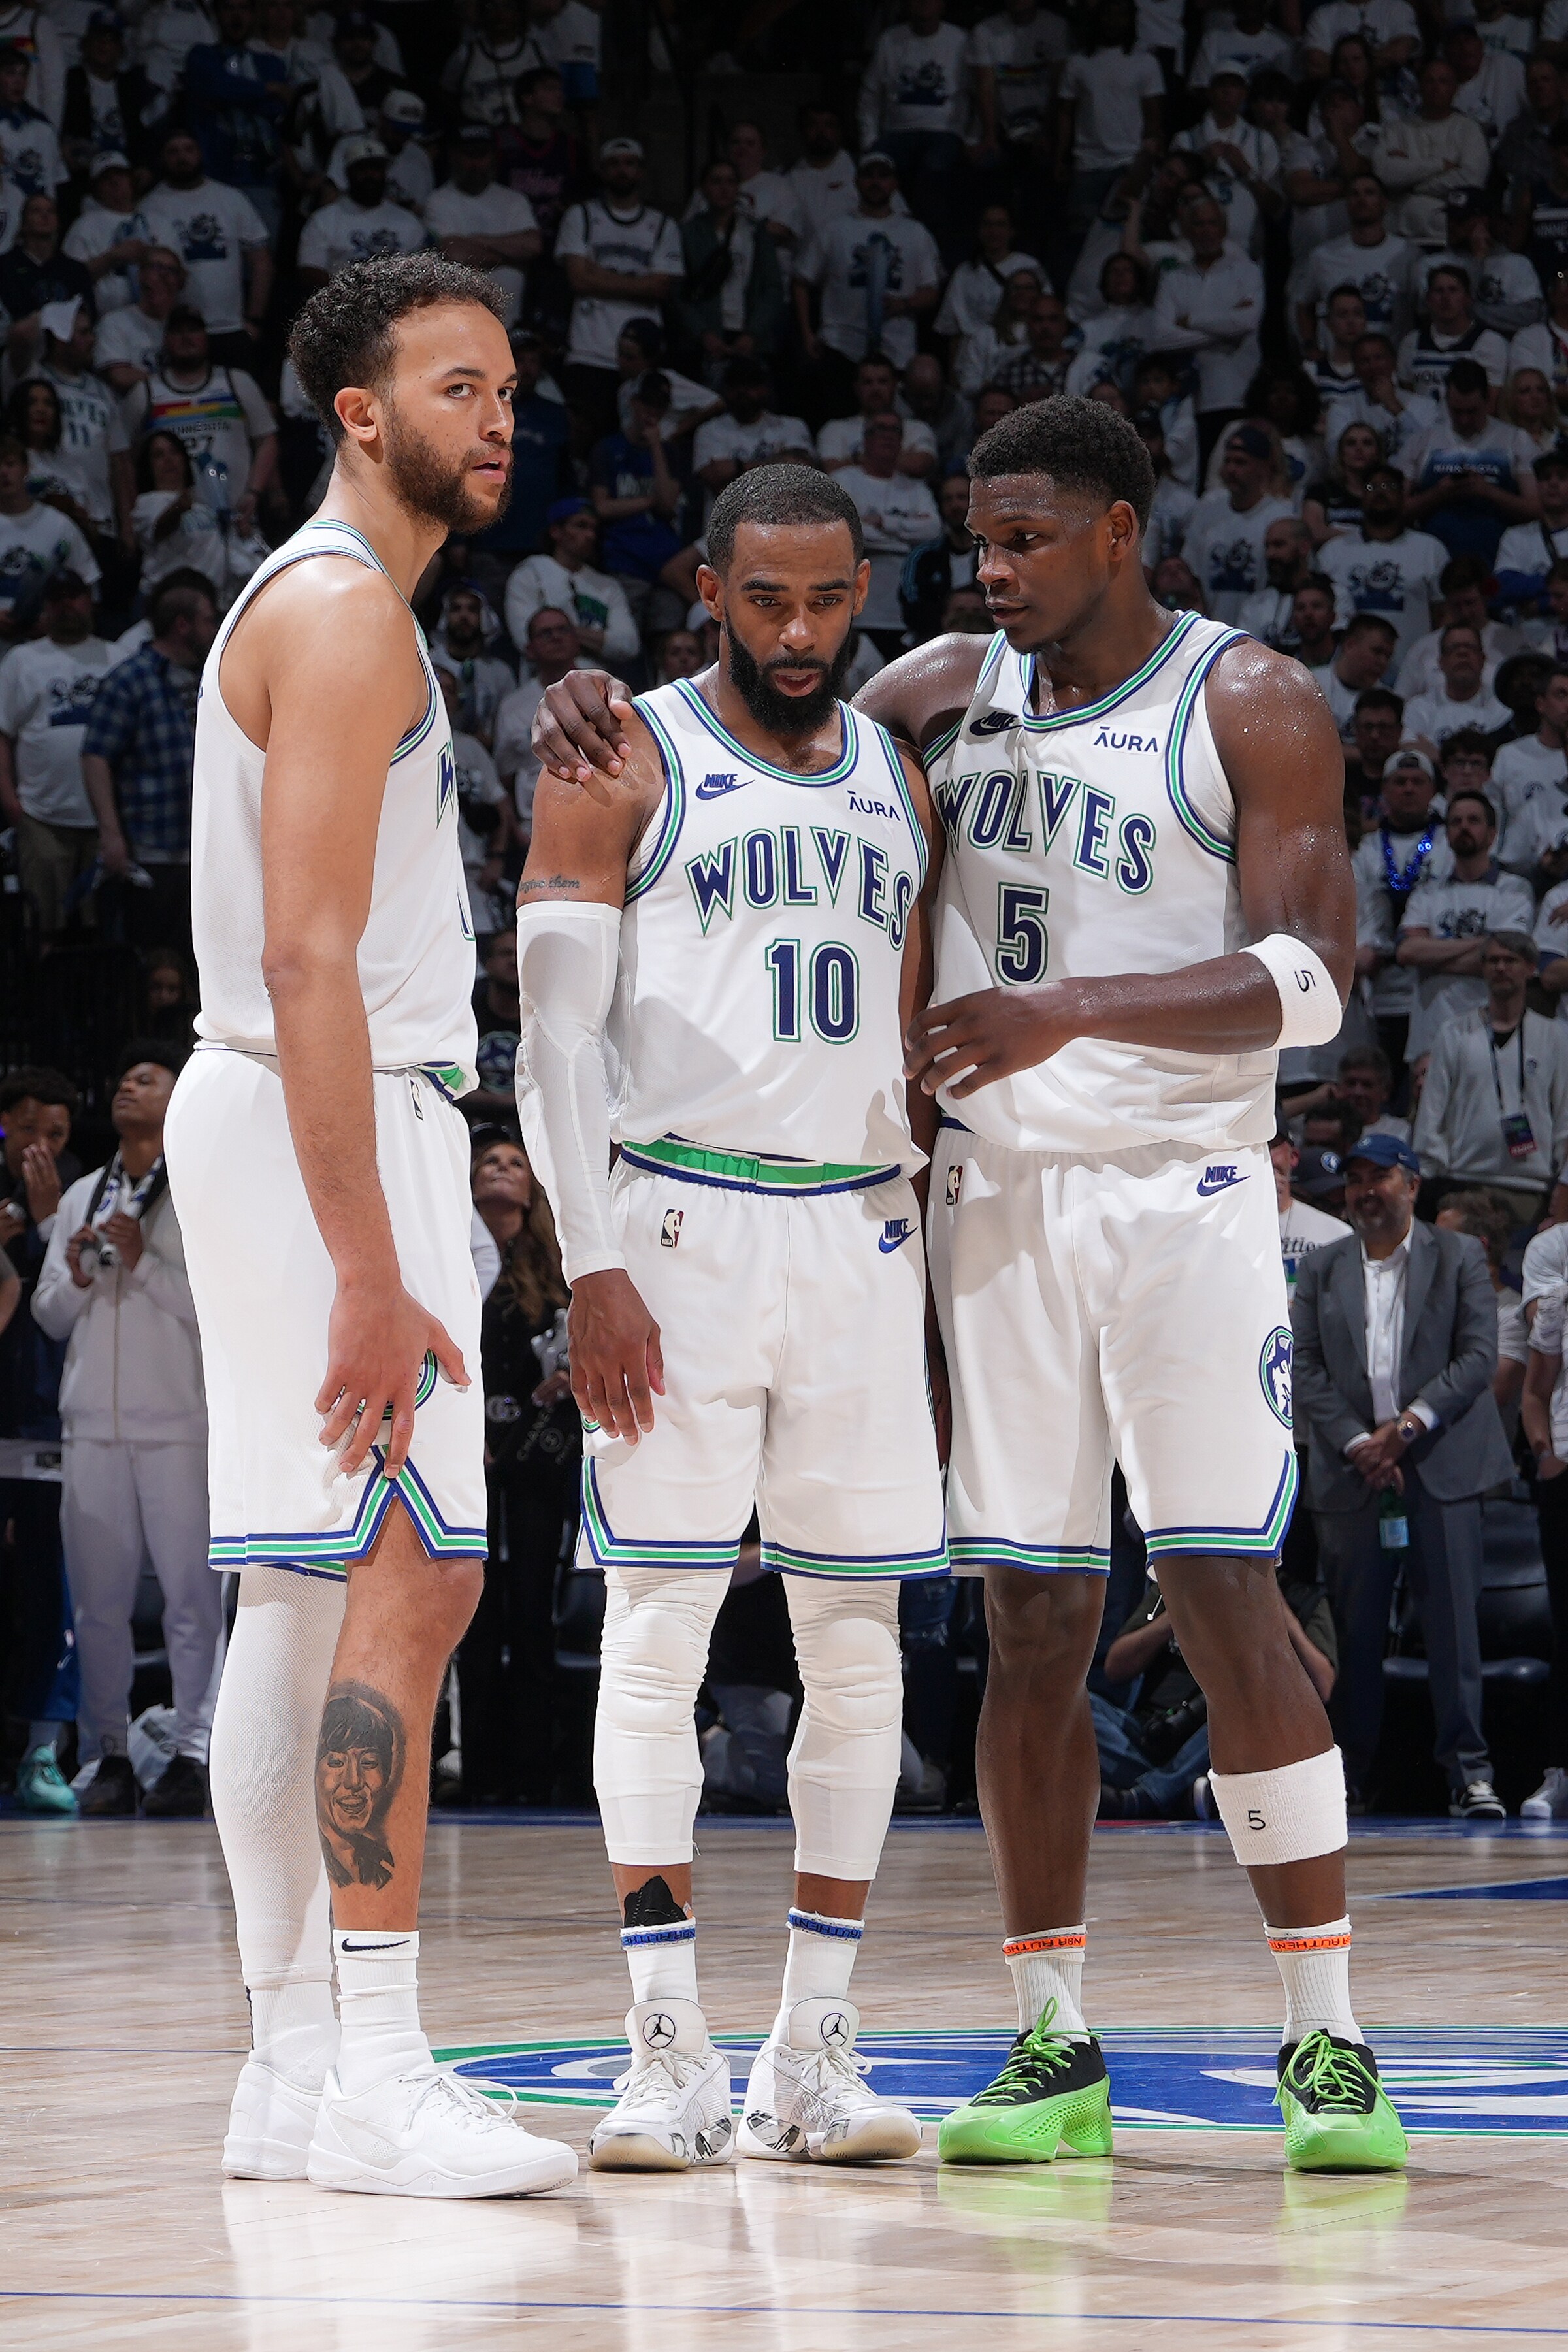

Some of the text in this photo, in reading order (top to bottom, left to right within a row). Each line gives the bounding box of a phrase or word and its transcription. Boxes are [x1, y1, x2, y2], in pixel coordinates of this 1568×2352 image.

[703, 774, 738, 789] NIKE
[935, 770, 1157, 896] WOLVES
[684, 825, 913, 951] WOLVES
[995, 882, 1049, 985] 5
[764, 938, 860, 1045] 10
[1294, 970, 1316, 992] 5
[1205, 1166, 1237, 1183] NIKE
[885, 1218, 909, 1239] NIKE
[1248, 1810, 1266, 1830] 5
[1058, 1936, 1082, 1946] NBA
